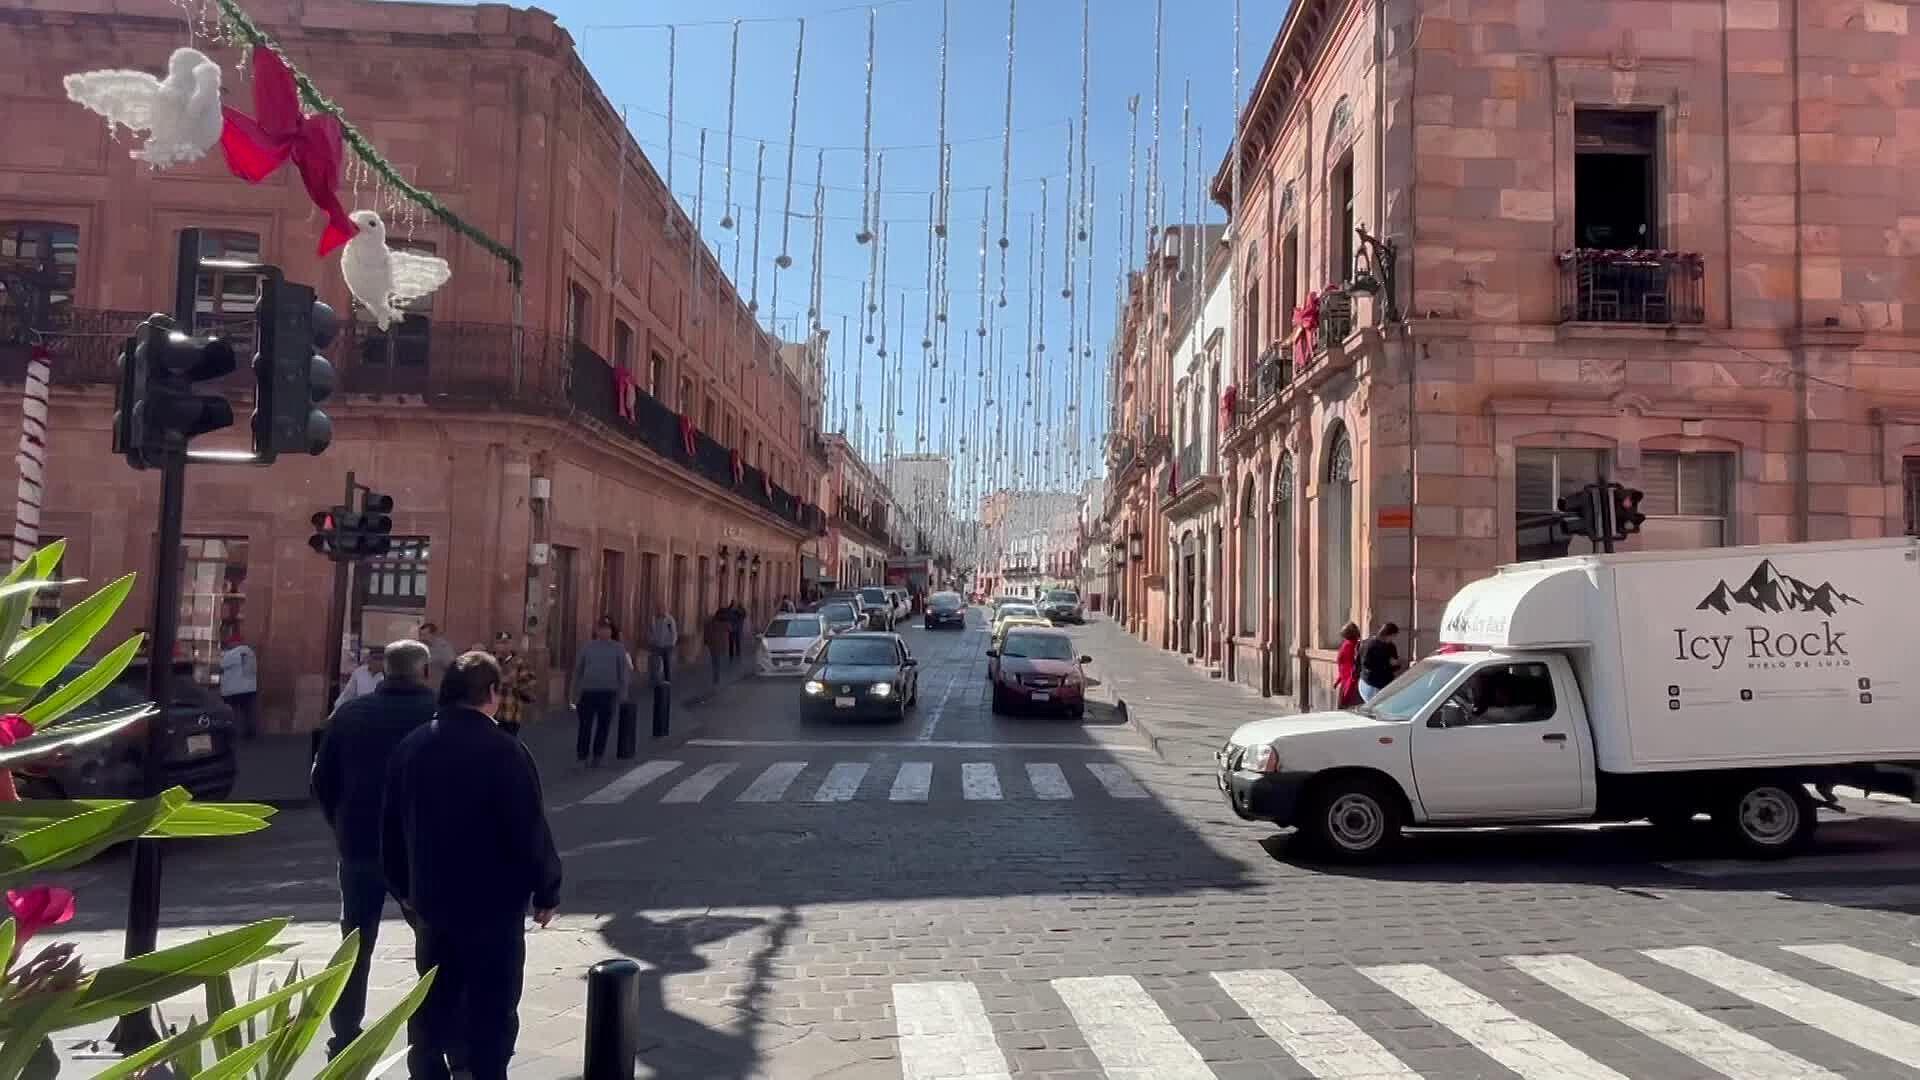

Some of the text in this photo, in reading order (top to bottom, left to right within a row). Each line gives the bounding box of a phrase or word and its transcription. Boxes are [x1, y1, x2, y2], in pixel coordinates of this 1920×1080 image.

[1673, 621, 1849, 670] Icy Rock
[1794, 660, 1809, 669] DE
